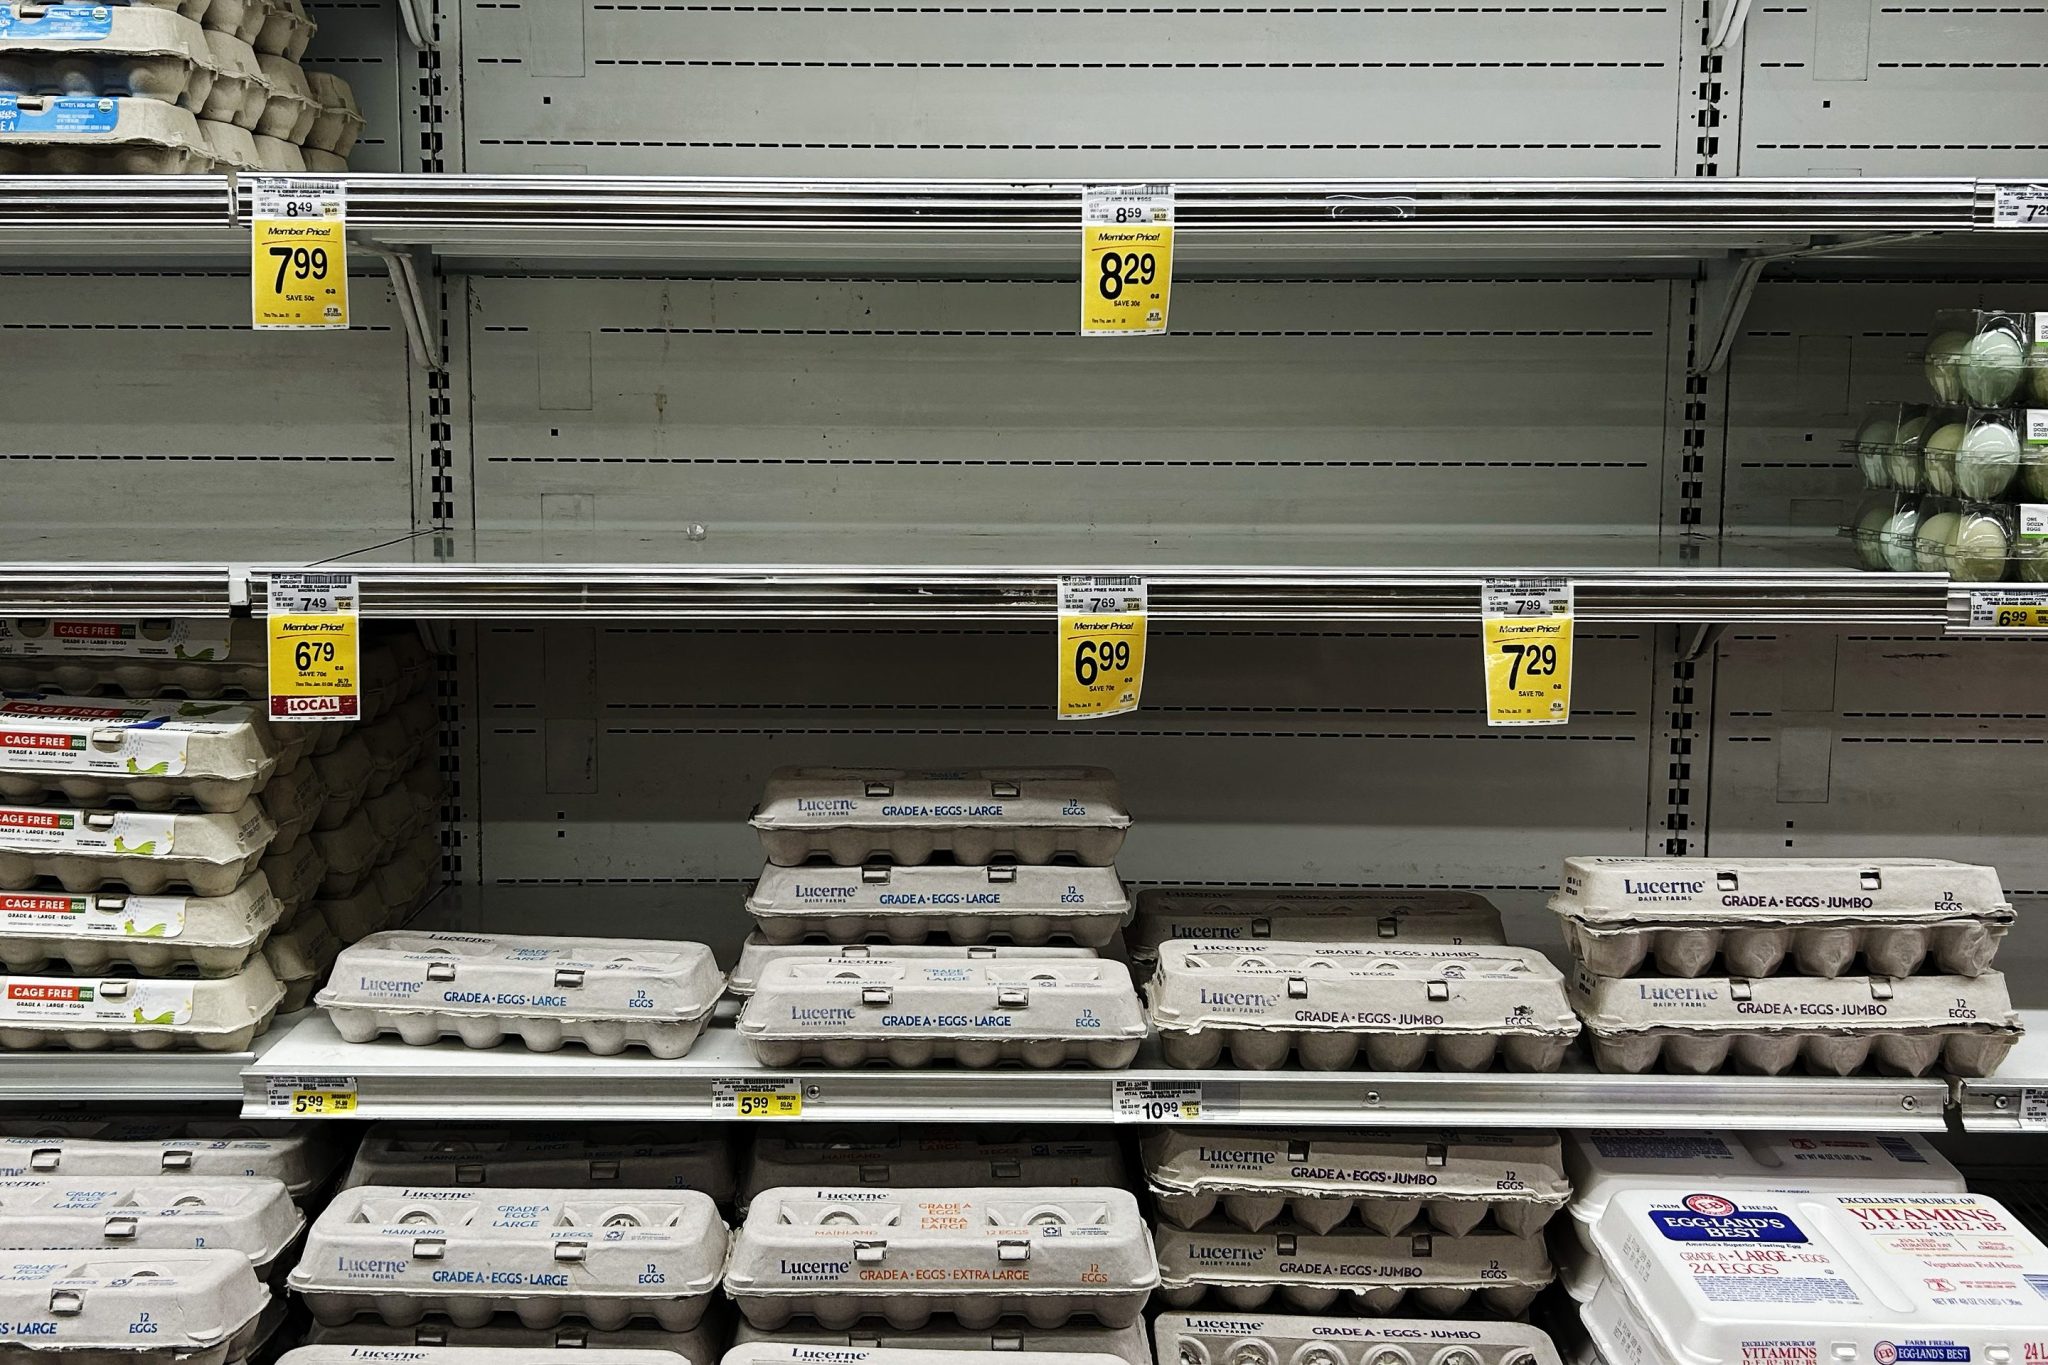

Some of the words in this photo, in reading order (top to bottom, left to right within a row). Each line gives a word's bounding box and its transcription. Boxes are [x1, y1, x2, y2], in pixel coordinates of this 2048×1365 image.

[1099, 233, 1135, 241] Member
[1136, 233, 1160, 241] Price!
[60, 626, 88, 634] CAGE
[92, 627, 115, 635] FREE
[283, 623, 317, 631] Member
[290, 699, 337, 711] LOCAL
[5, 736, 36, 745] CAGE
[39, 737, 65, 746] FREE
[0, 814, 24, 823] AGE
[28, 816, 52, 825] FREE
[796, 884, 858, 897] Lucerne
[1068, 886, 1076, 894] 12
[1625, 879, 1705, 894] Lucerne
[879, 893, 917, 904] GRADE
[917, 894, 926, 904] A
[932, 893, 959, 904] EGGS
[966, 893, 1000, 904] LARGE
[1061, 894, 1084, 903] EGGS
[1722, 895, 1767, 908] GRADE
[1767, 896, 1777, 908] A
[1786, 896, 1819, 908] EGGS
[1827, 896, 1873, 909] JUMBO
[1943, 892, 1953, 901] 12
[5, 899, 36, 908] CAGE
[40, 900, 64, 909] FREE
[1934, 902, 1963, 912] EGGS
[1172, 924, 1243, 938] Lucerne
[361, 977, 423, 993] Lucerne
[14, 988, 44, 997] CAGE
[48, 989, 73, 998] FREE
[637, 990, 646, 999] 12
[1200, 988, 1280, 1006] Lucerne
[443, 991, 481, 1004] GRADE
[481, 994, 490, 1004] A
[497, 994, 525, 1006] EGGS
[532, 995, 567, 1007] LARGE
[629, 999, 653, 1008] EGGS
[791, 1006, 855, 1020] Lucerne
[1083, 1009, 1092, 1017] 12
[1295, 1010, 1340, 1023] GRADE
[1340, 1012, 1350, 1023] A
[1358, 1013, 1391, 1024] EGGS
[1398, 1014, 1443, 1025] JUMBO
[882, 1015, 922, 1027] GRADE
[922, 1016, 931, 1027] A
[937, 1016, 967, 1027] EGGS
[974, 1016, 1011, 1027] LARGE
[1075, 1018, 1100, 1027] EGGS
[1200, 1147, 1275, 1164] Lucerne
[1291, 1167, 1335, 1180] GRADE
[1335, 1169, 1345, 1180] A
[1353, 1170, 1386, 1182] EGGS
[1392, 1173, 1437, 1185] JUMBO
[1506, 1171, 1516, 1180] 12
[1497, 1180, 1524, 1191] EGGS
[1848, 1208, 1997, 1221] VITAMINS
[1705, 1228, 1760, 1238] BEST
[1189, 1243, 1266, 1260] Lucerne
[1680, 1252, 1715, 1261] GRADE
[1735, 1251, 1792, 1262] LARGE
[1800, 1254, 1829, 1263] EGGS
[338, 1256, 408, 1273] Lucerne
[647, 1264, 657, 1273] 12
[780, 1259, 852, 1275] Lucerne
[1091, 1263, 1099, 1272] 12
[1280, 1262, 1323, 1274] GRADE
[1323, 1264, 1333, 1275] A
[1340, 1264, 1372, 1276] EGGS
[1379, 1266, 1423, 1277] JUMBO
[1490, 1260, 1499, 1269] 12
[1689, 1263, 1717, 1274] 24
[1719, 1264, 1779, 1274] EGGS
[433, 1270, 474, 1283] GRADE
[474, 1272, 484, 1284] A
[491, 1272, 522, 1285] EGGS
[530, 1273, 569, 1286] LARGE
[638, 1274, 665, 1284] EGGS
[860, 1269, 899, 1280] GRADE
[900, 1270, 909, 1280] A
[916, 1269, 946, 1280] EGGS
[953, 1269, 990, 1280] EXTRA
[993, 1269, 1029, 1281] LARGE
[1081, 1273, 1107, 1283] EGGS
[1481, 1270, 1507, 1279] EGGS
[140, 1312, 149, 1322] 12
[16, 1322, 58, 1334] LARGE
[129, 1323, 158, 1334] EGGS
[1742, 1348, 1817, 1359] VITAMINS
[1947, 1349, 1967, 1359] BEST
[2024, 1343, 2038, 1359] 24
